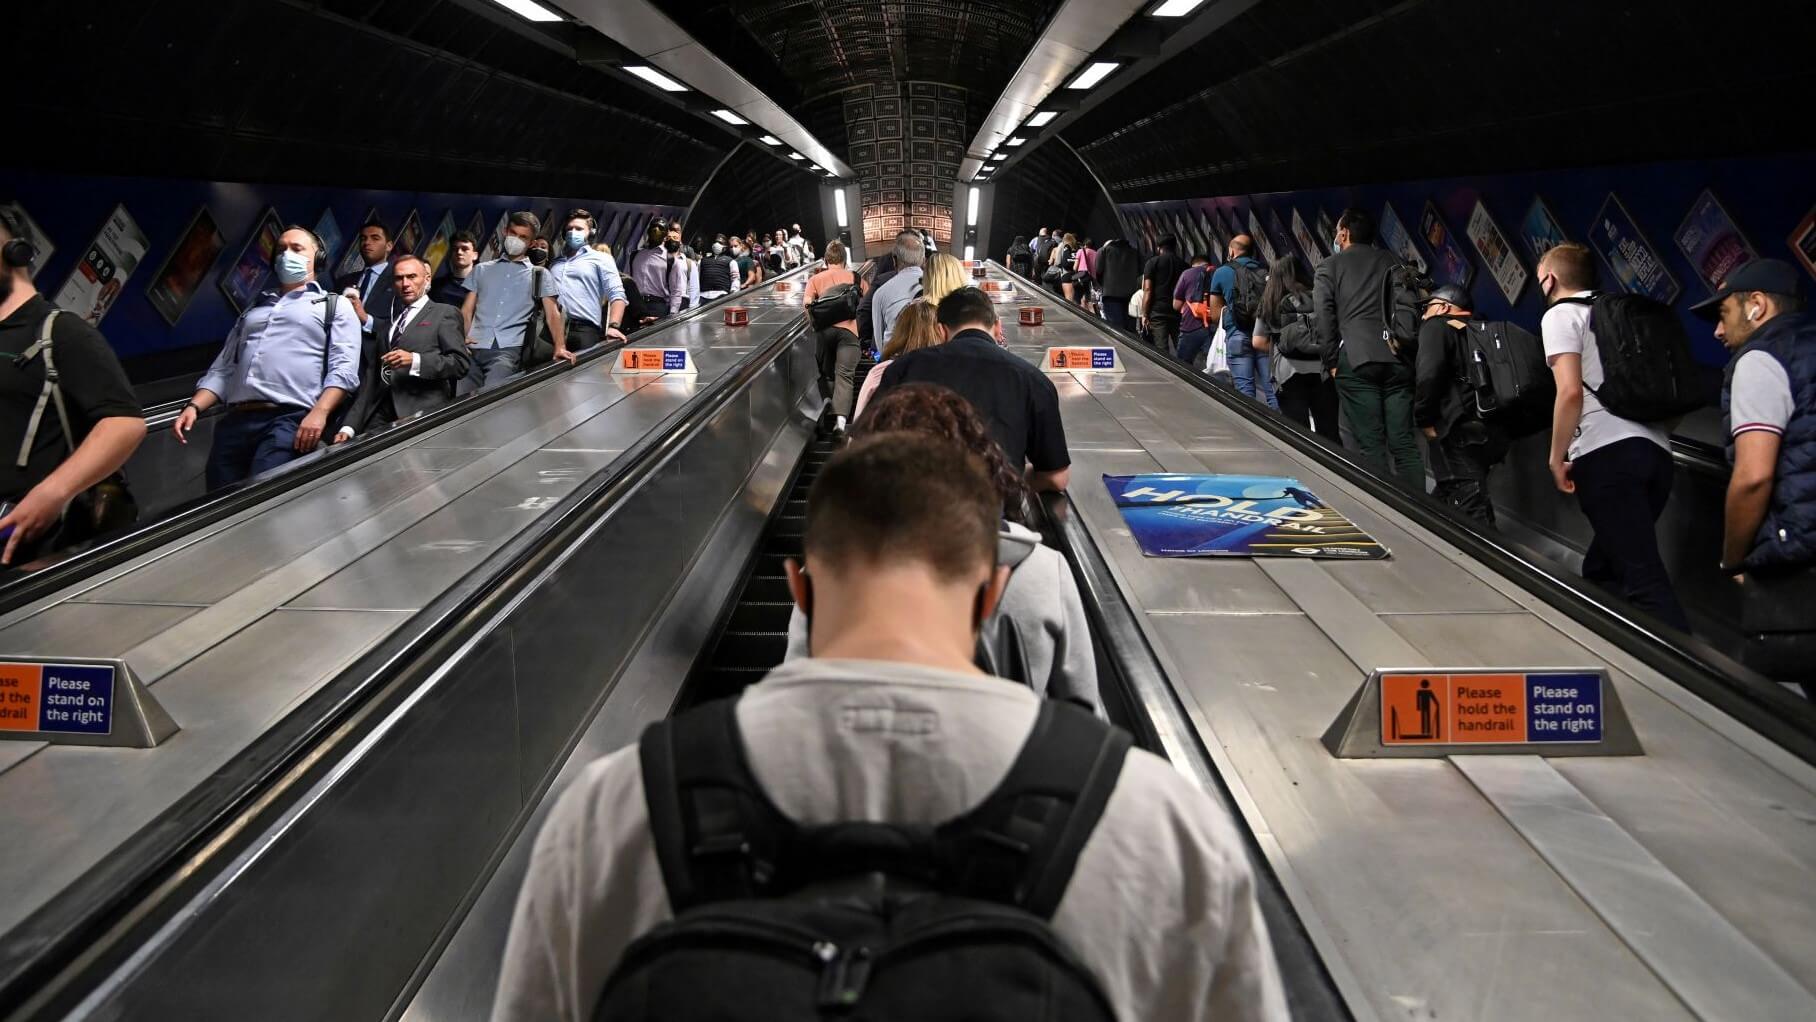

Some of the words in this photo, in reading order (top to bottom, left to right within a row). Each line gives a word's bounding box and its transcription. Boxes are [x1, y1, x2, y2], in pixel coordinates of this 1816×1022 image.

[1122, 487, 1324, 523] HOLD
[49, 676, 91, 691] Please
[9, 692, 31, 704] the
[1457, 686, 1502, 699] Please
[1533, 685, 1579, 699] Please
[47, 693, 84, 706] stand
[87, 696, 105, 707] on
[1458, 703, 1489, 715] hold
[1493, 703, 1517, 715] the
[1534, 702, 1573, 715] stand
[1576, 703, 1595, 715] on
[47, 709, 69, 721] the
[73, 710, 104, 725] right
[1458, 719, 1515, 731] handrail
[1534, 719, 1558, 731] the
[1561, 717, 1595, 733] right
